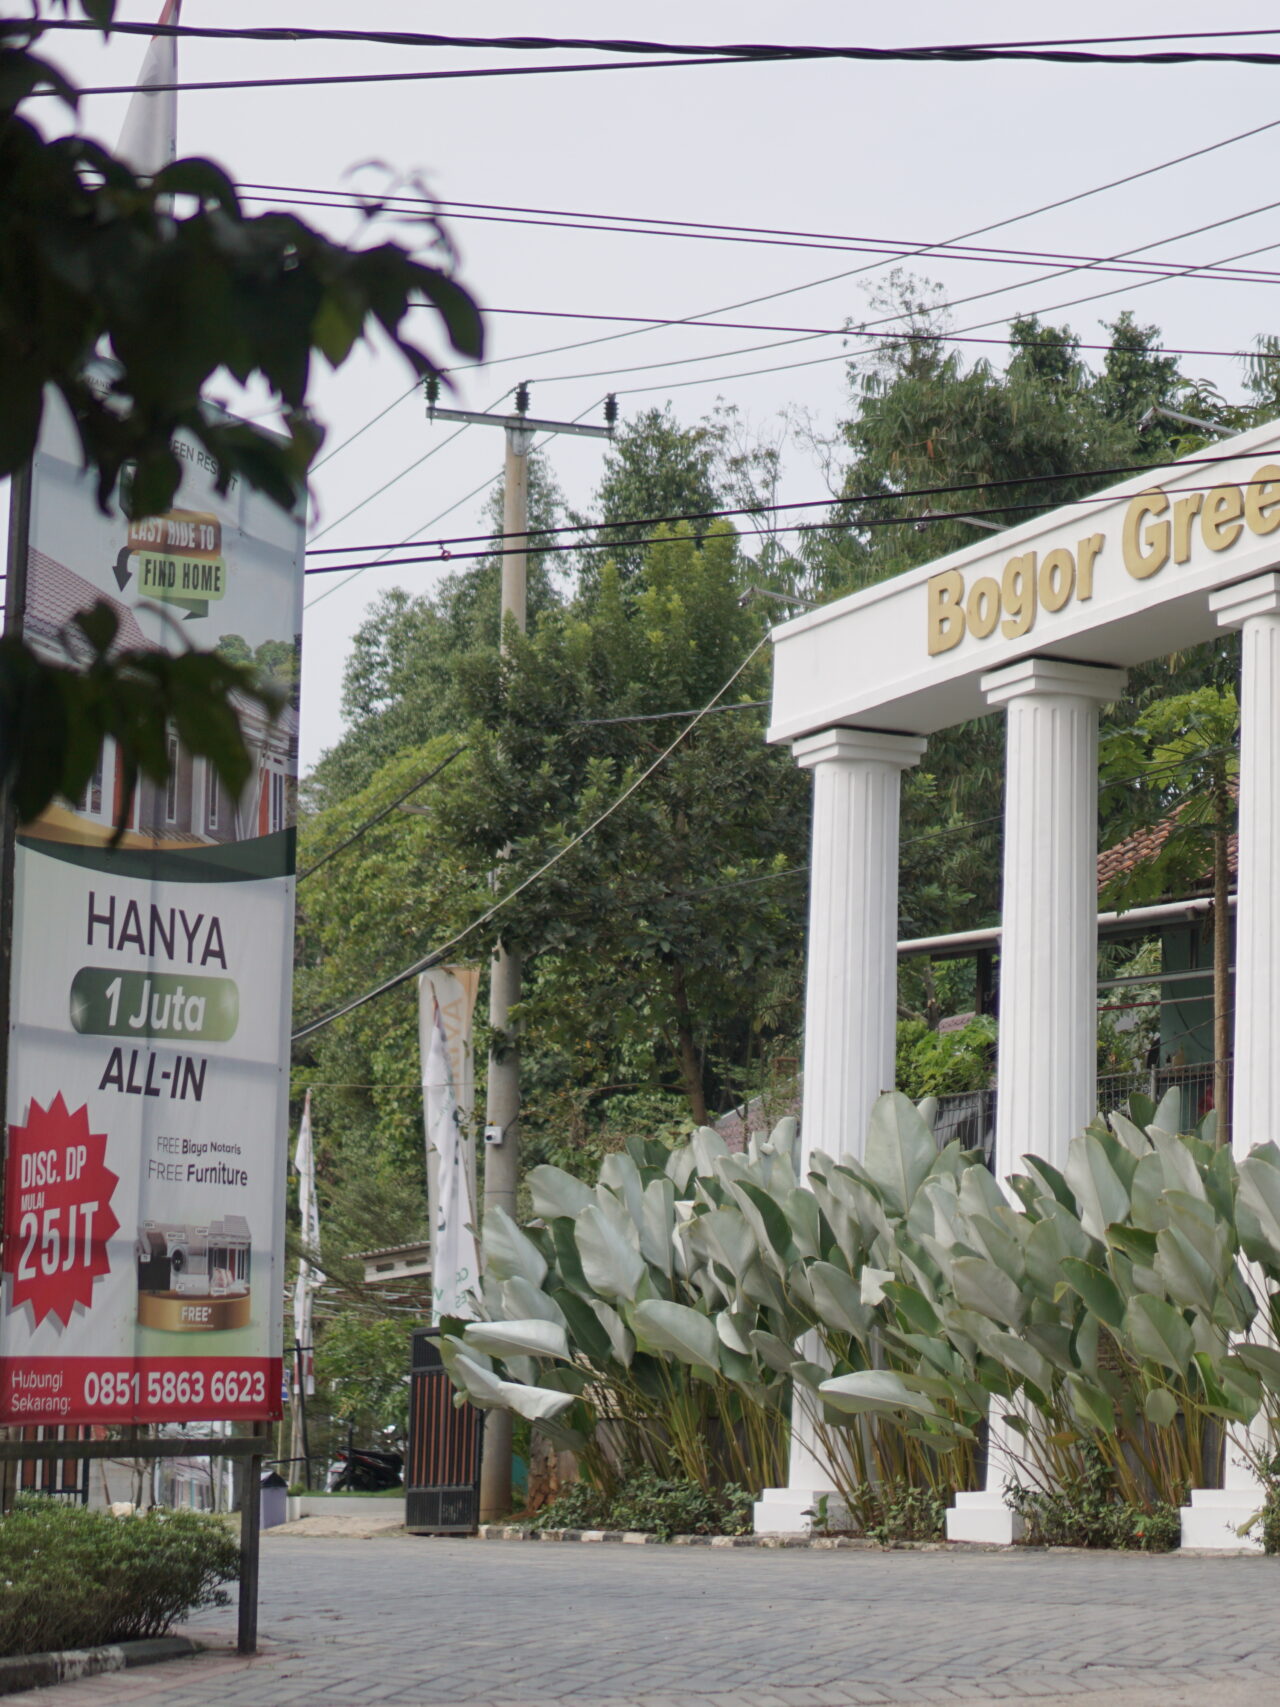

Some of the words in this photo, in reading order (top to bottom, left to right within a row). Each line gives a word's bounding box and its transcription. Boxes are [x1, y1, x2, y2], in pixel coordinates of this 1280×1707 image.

[197, 450, 238, 491] REST
[131, 518, 162, 543] LAST
[167, 521, 196, 549] RIDE
[200, 525, 215, 550] TO
[144, 559, 176, 588] FIND
[182, 563, 221, 592] HOME
[927, 532, 1105, 656] Bogor
[87, 890, 228, 970] HANYA
[105, 977, 122, 1026] 1
[129, 979, 206, 1032] Juta
[98, 1047, 208, 1102] ALL-IN
[157, 1136, 180, 1154] FREE
[181, 1139, 208, 1157] Biaya
[210, 1141, 242, 1156] Notaris
[21, 1150, 61, 1189] DISC.
[65, 1145, 87, 1181] DP
[149, 1159, 183, 1182] FREE
[187, 1163, 248, 1187] Furniture
[21, 1192, 45, 1212] MULAI
[18, 1201, 99, 1281] 25JT
[11, 1371, 64, 1392] Hubungi
[84, 1371, 140, 1405] 0851
[147, 1371, 204, 1404] 5863
[210, 1371, 266, 1403] 6623
[11, 1393, 71, 1415] Sekarang:
